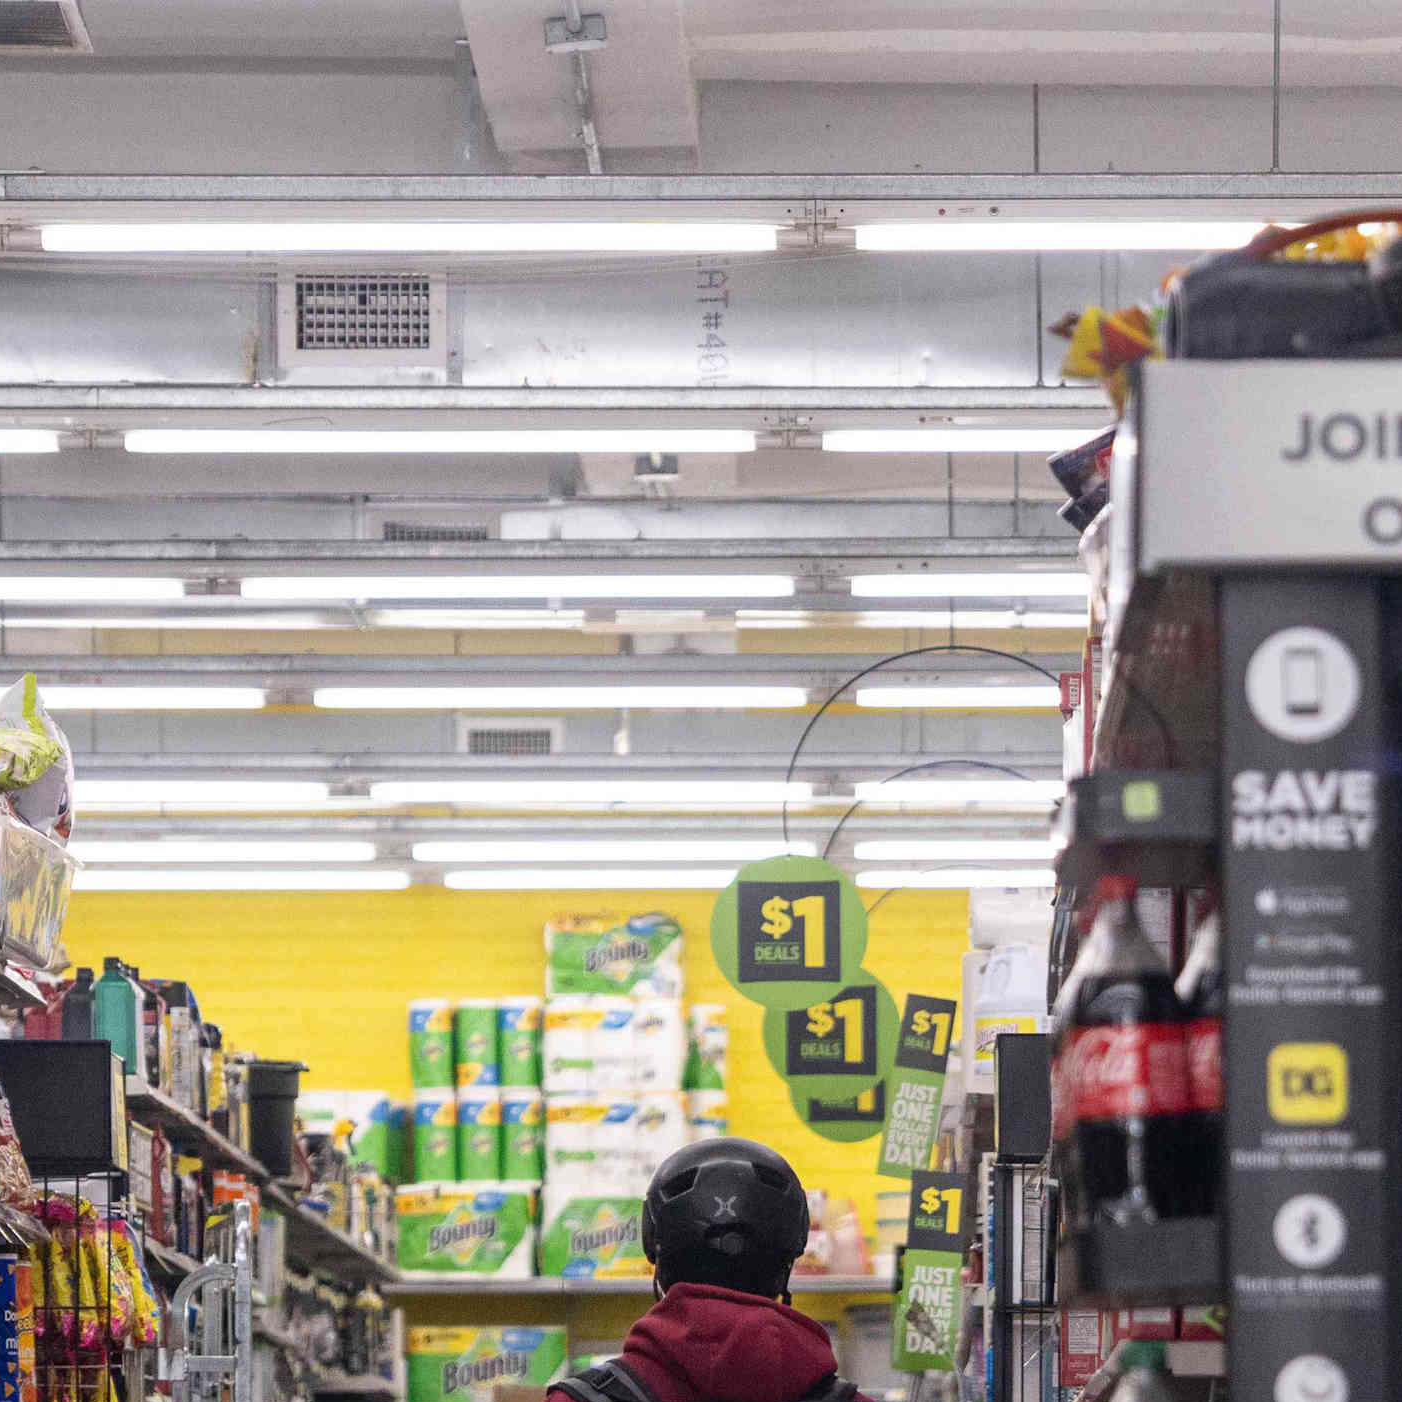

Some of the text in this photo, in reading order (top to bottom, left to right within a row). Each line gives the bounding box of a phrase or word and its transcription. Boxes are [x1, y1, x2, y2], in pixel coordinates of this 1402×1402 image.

[1231, 770, 1377, 815] SAVE
[1231, 814, 1376, 851] MONEY
[760, 895, 826, 968] $1
[585, 938, 649, 973] Bounty
[754, 945, 800, 962] DEALS
[806, 998, 864, 1063] $1
[911, 1009, 951, 1056] $1
[800, 1043, 840, 1057] DEALS
[897, 1083, 938, 1102] JUST
[1280, 1066, 1334, 1099] DG
[892, 1100, 935, 1122] ONE
[885, 1143, 929, 1167] DAY
[919, 1186, 963, 1235] $1
[429, 1214, 497, 1252] Bounty
[911, 1264, 956, 1284] JUST
[908, 1284, 953, 1307] ONE
[443, 1350, 530, 1396] Bounty
